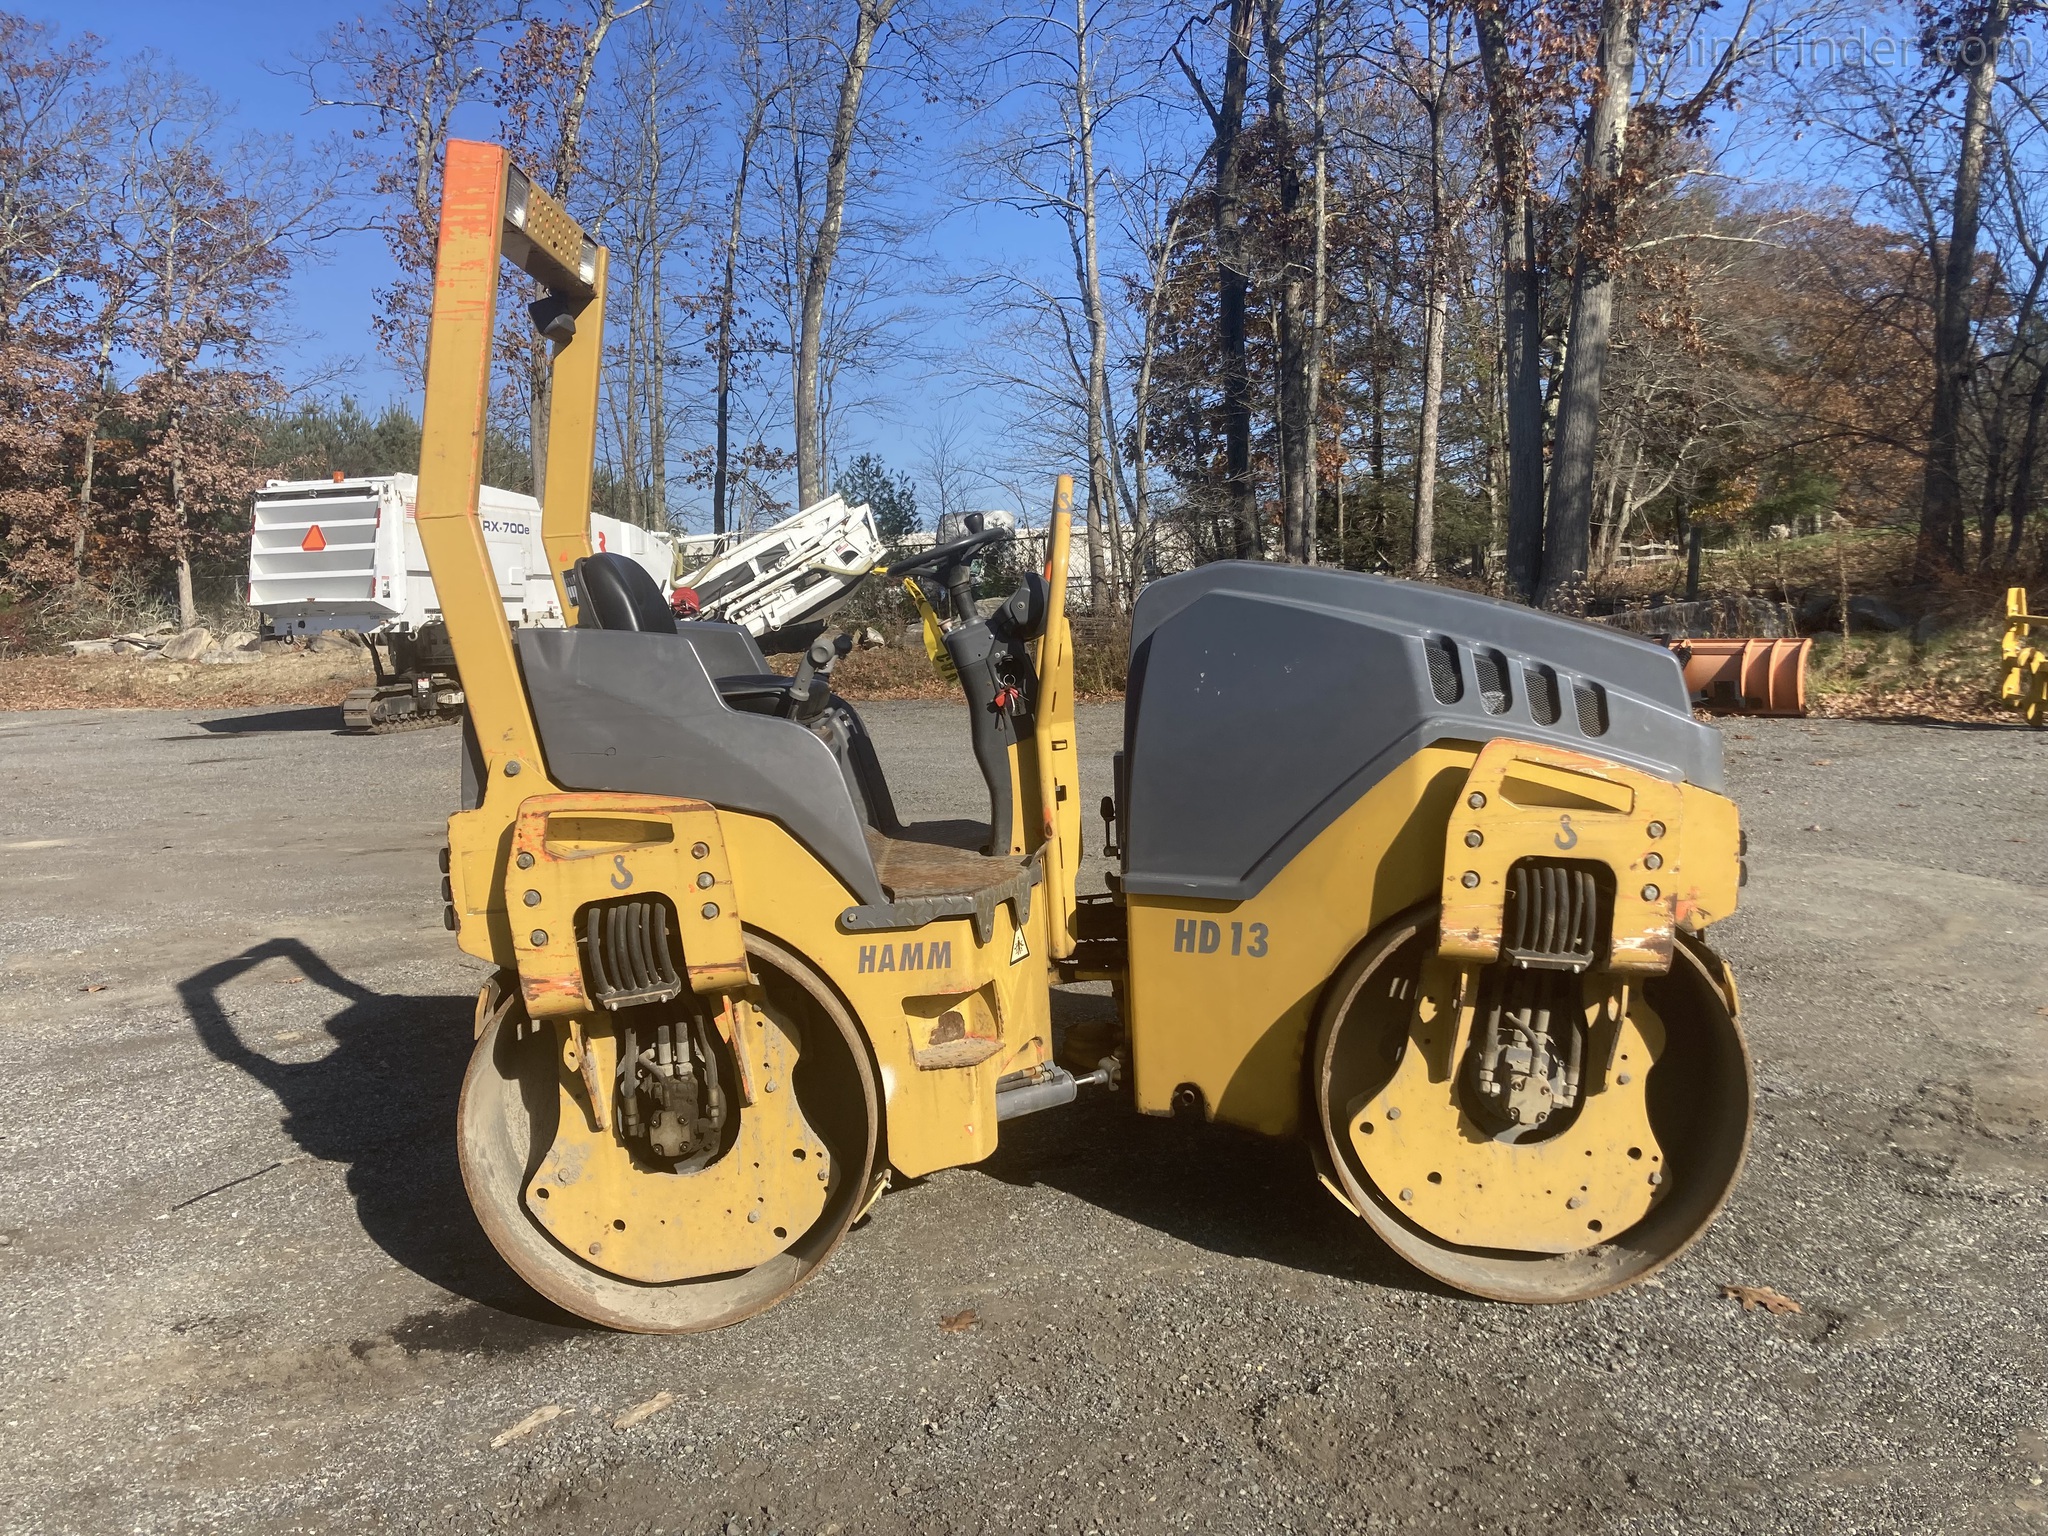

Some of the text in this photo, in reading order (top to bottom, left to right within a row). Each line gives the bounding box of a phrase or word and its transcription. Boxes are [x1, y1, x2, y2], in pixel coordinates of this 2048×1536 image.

[482, 520, 530, 535] RX-700e
[1173, 918, 1269, 958] HD 13
[858, 940, 951, 974] HAMM
